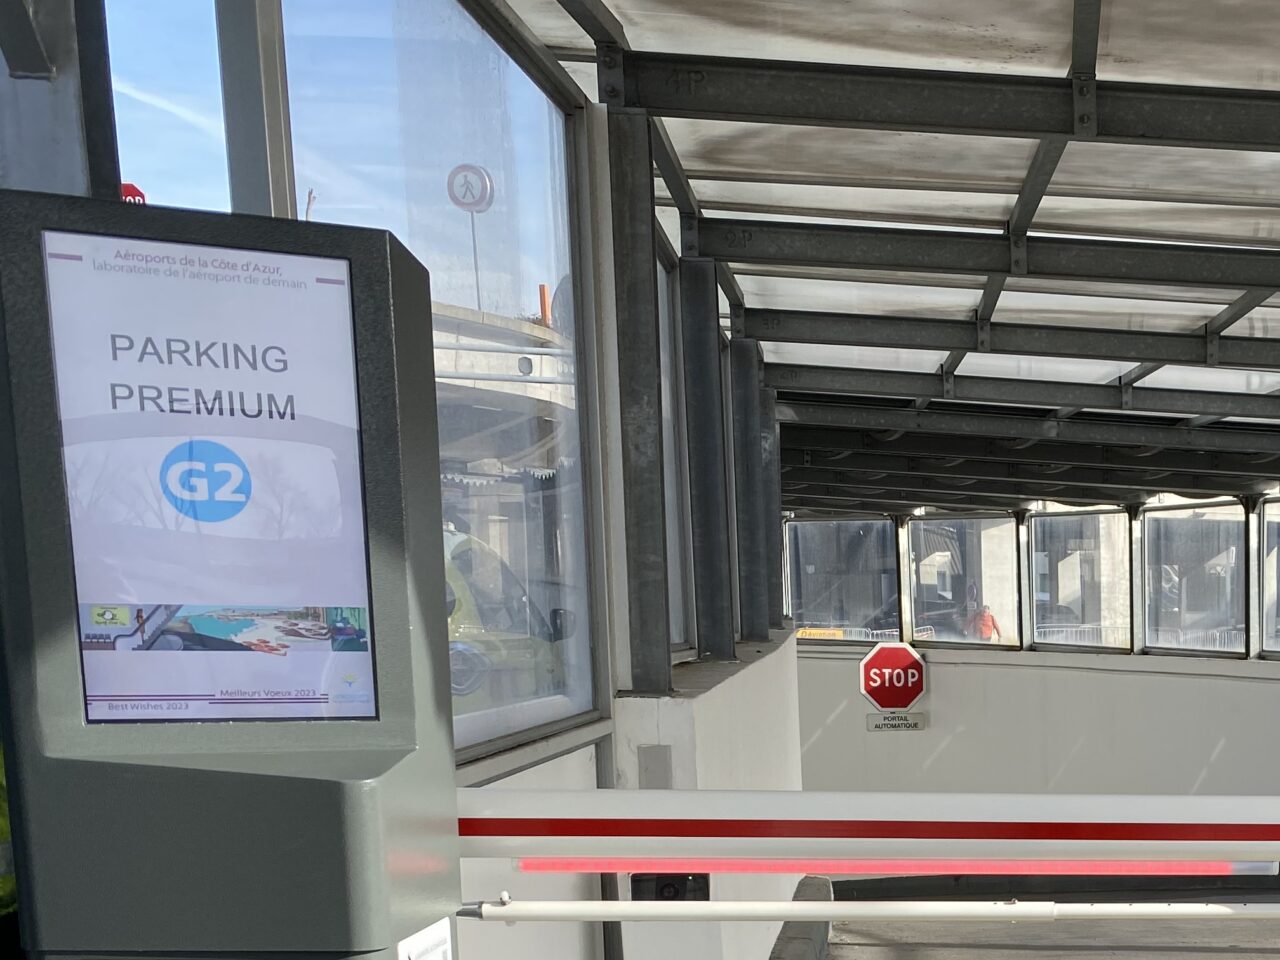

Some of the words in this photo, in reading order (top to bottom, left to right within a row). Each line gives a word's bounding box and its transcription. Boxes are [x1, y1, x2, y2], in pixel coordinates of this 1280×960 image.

[92, 259, 161, 276] laboratoire
[163, 266, 180, 278] de
[182, 267, 241, 283] l'aéroport
[243, 274, 260, 285] de
[262, 275, 308, 290] demain
[114, 250, 176, 265] Aéroports
[179, 255, 196, 267] de
[198, 257, 209, 268] la
[211, 258, 238, 271] Côte
[241, 261, 282, 276] d'Azur,
[110, 333, 288, 373] PARKING
[110, 382, 296, 421] PREMIUM
[166, 461, 247, 503] G2
[869, 668, 919, 688] STOP
[108, 703, 128, 711] Best
[130, 702, 164, 711] Wishes
[166, 702, 189, 711] 2023
[220, 689, 260, 698] Meilleurs
[263, 689, 292, 697] Voeux
[294, 689, 317, 697] 2023
[874, 722, 919, 730] AUTOMATIQUE
